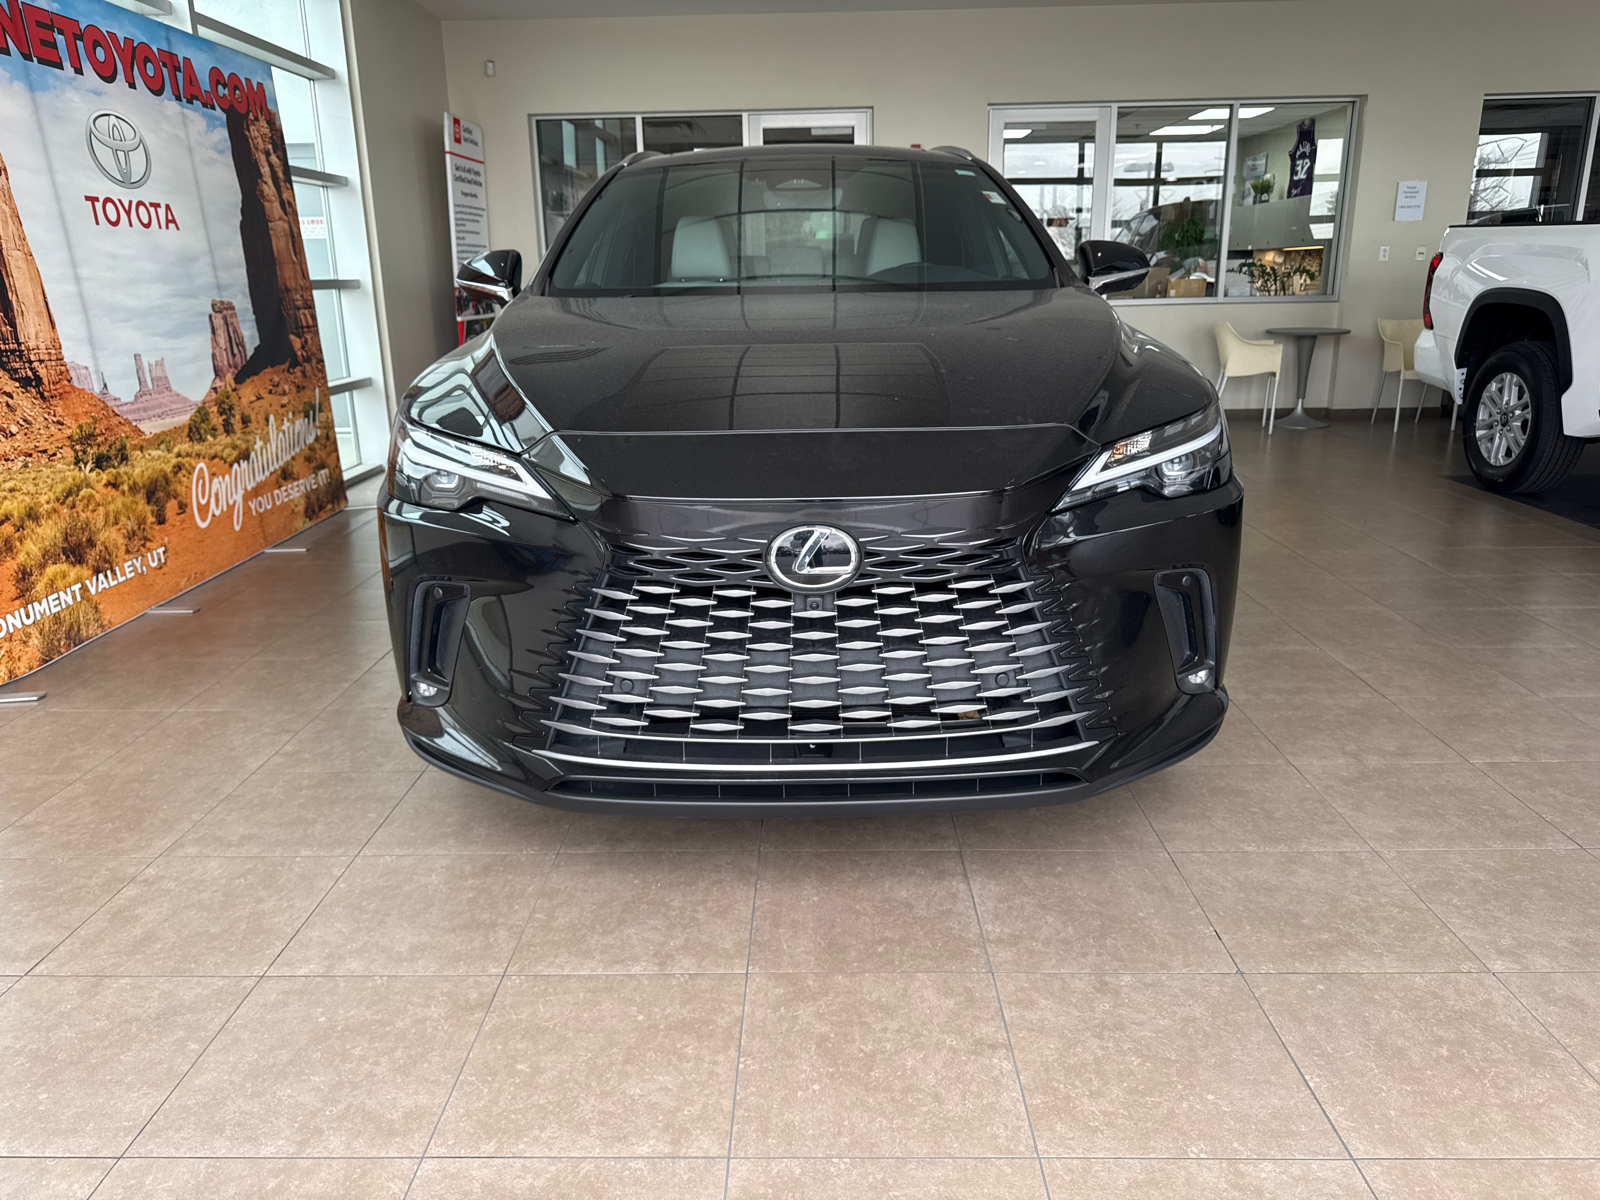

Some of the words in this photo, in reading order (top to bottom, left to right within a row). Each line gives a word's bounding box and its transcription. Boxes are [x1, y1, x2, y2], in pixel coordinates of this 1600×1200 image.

[0, 0, 270, 120] NETOYOTA.COM
[1293, 159, 1311, 180] 32
[84, 195, 180, 231] TOYOTA
[192, 387, 321, 531] Congratulations!
[248, 493, 273, 516] YOU
[273, 472, 318, 506] DESERVE
[317, 468, 331, 486] IT!
[85, 556, 148, 596] VALLEY,
[147, 546, 166, 568] UT
